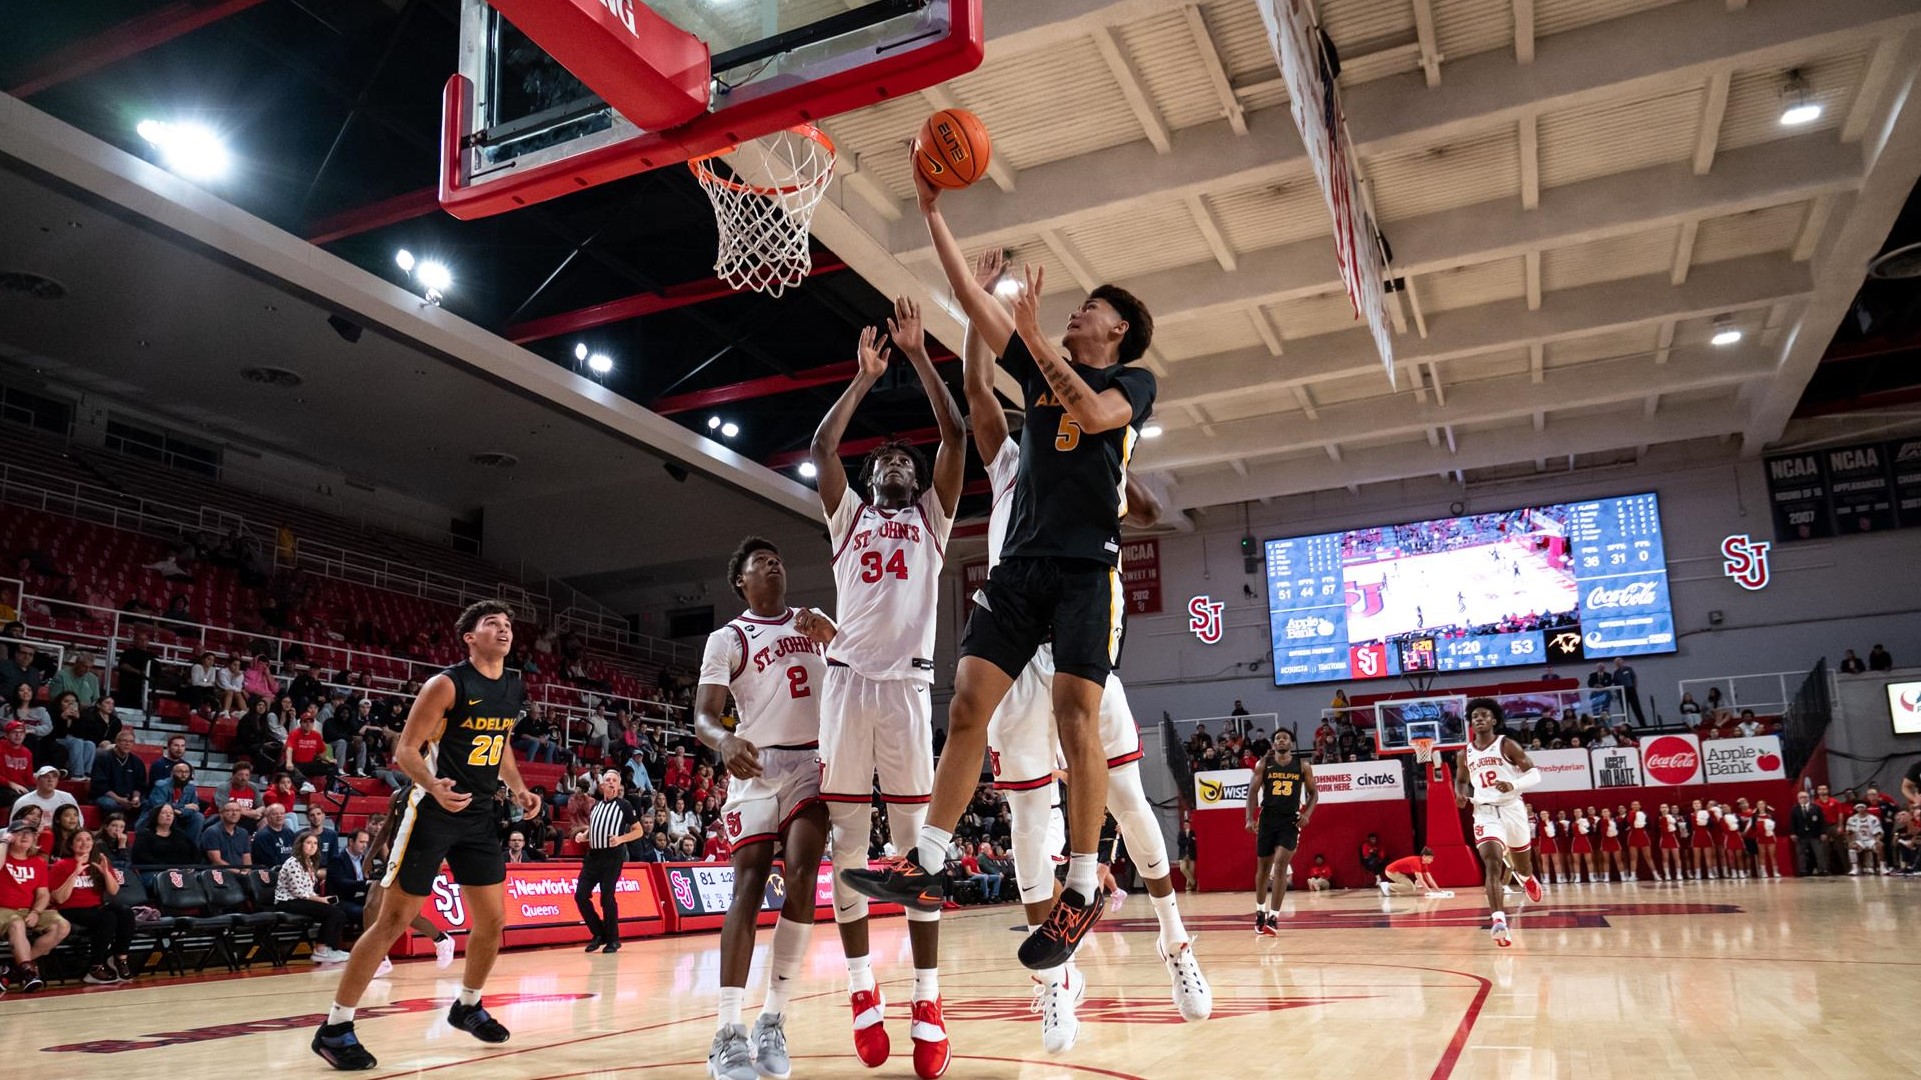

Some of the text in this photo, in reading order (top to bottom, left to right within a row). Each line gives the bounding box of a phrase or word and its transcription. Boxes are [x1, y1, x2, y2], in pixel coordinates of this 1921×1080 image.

[937, 122, 969, 163] ELITE
[1055, 412, 1081, 452] 5
[1770, 455, 1818, 480] NCAA
[1829, 448, 1879, 472] NCAA
[1122, 543, 1155, 561] NCAA
[1610, 553, 1626, 565] 31
[1638, 550, 1649, 562] 0
[861, 548, 909, 584] 34
[1278, 584, 1336, 600] 51 44 67
[1285, 616, 1319, 630] Apple
[1285, 627, 1317, 640] Bank
[1448, 639, 1534, 655] 1:20 53
[787, 665, 811, 699] 2
[467, 734, 505, 767] 20
[1706, 746, 1756, 763] Apple
[1647, 752, 1696, 769] Coca-Cola
[1709, 761, 1754, 776] Bank
[1268, 771, 1300, 781] ADELPHI
[1315, 773, 1352, 784] OHNNIES
[1479, 770, 1498, 788] 12
[1599, 768, 1636, 786] NO HATE
[1224, 784, 1249, 799] WISE
[1272, 780, 1293, 796] 23
[699, 871, 716, 886] 81
[521, 904, 560, 918] Queens
[706, 899, 726, 910] 4 2
